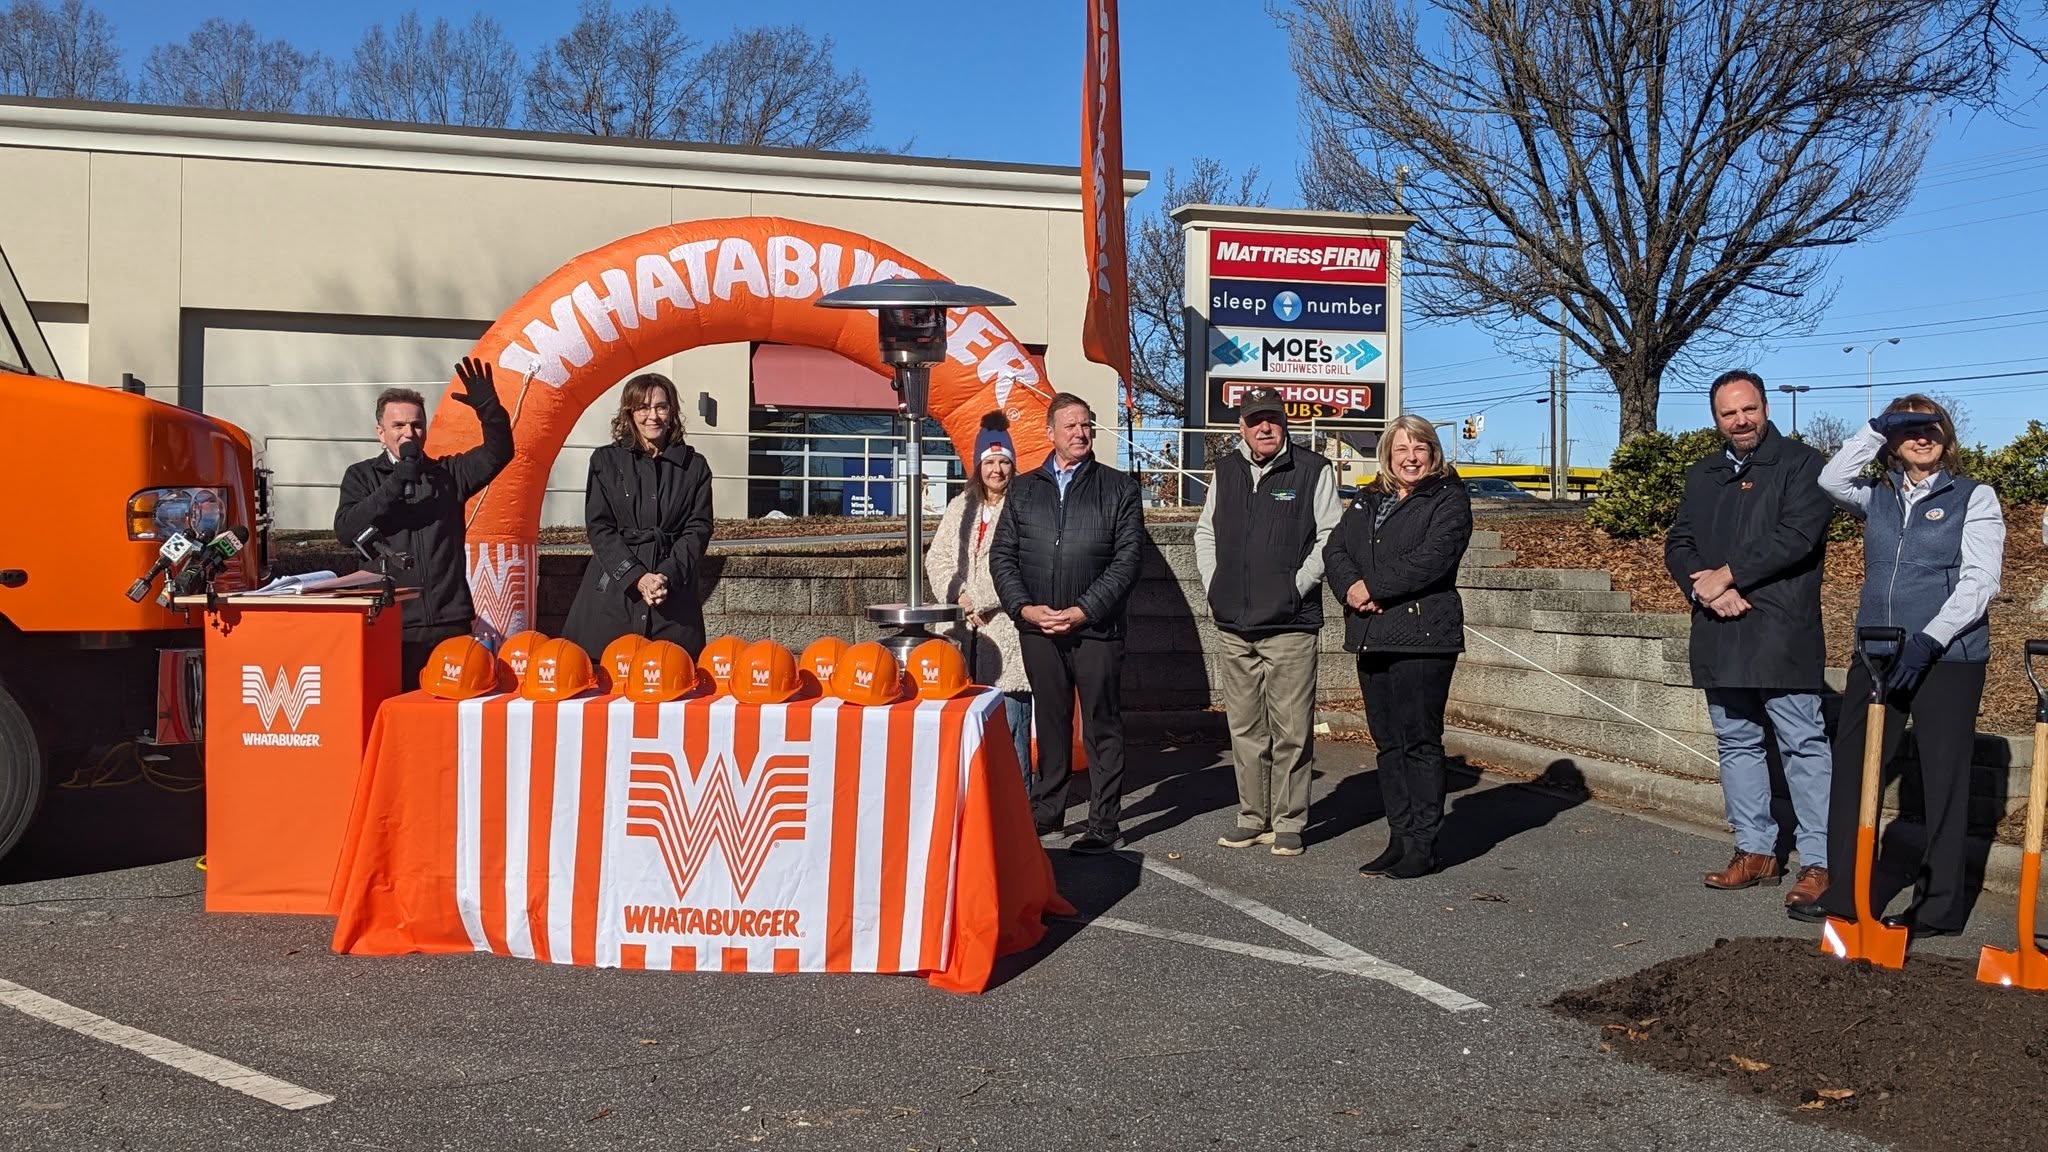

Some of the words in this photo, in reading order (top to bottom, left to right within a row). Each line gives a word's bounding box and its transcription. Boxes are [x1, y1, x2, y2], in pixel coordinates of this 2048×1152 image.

[1212, 291, 1267, 316] sleep
[1307, 297, 1382, 315] number
[498, 235, 1040, 409] WHATABUER
[1269, 362, 1323, 374] SOUTHWEST
[1228, 385, 1367, 412] FHOUSE
[1284, 403, 1323, 417] UBS
[226, 531, 244, 551] WCCB
[242, 732, 321, 747] WHATABURGER
[623, 905, 801, 938] WHATABURGER
